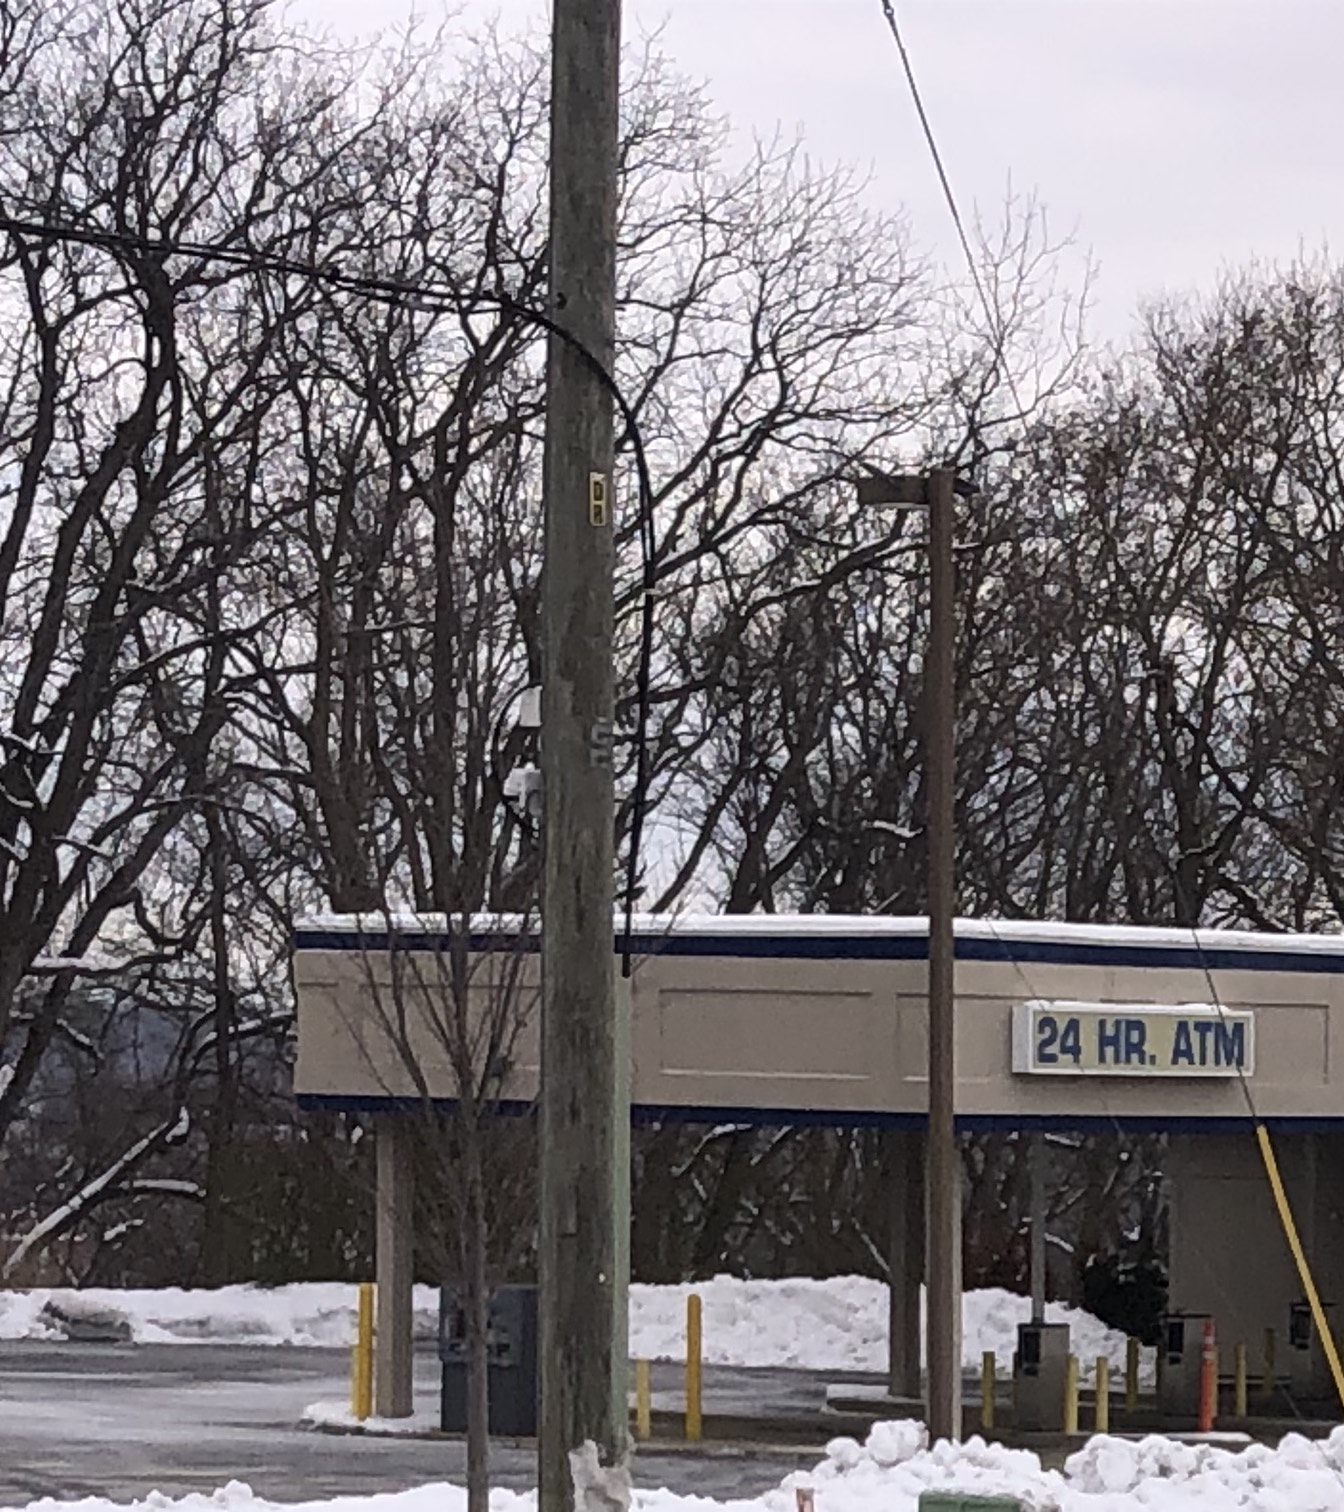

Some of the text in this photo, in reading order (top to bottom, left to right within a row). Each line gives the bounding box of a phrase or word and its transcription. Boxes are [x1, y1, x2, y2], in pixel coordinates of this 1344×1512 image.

[1037, 1016, 1246, 1067] 24 HR. ATM
